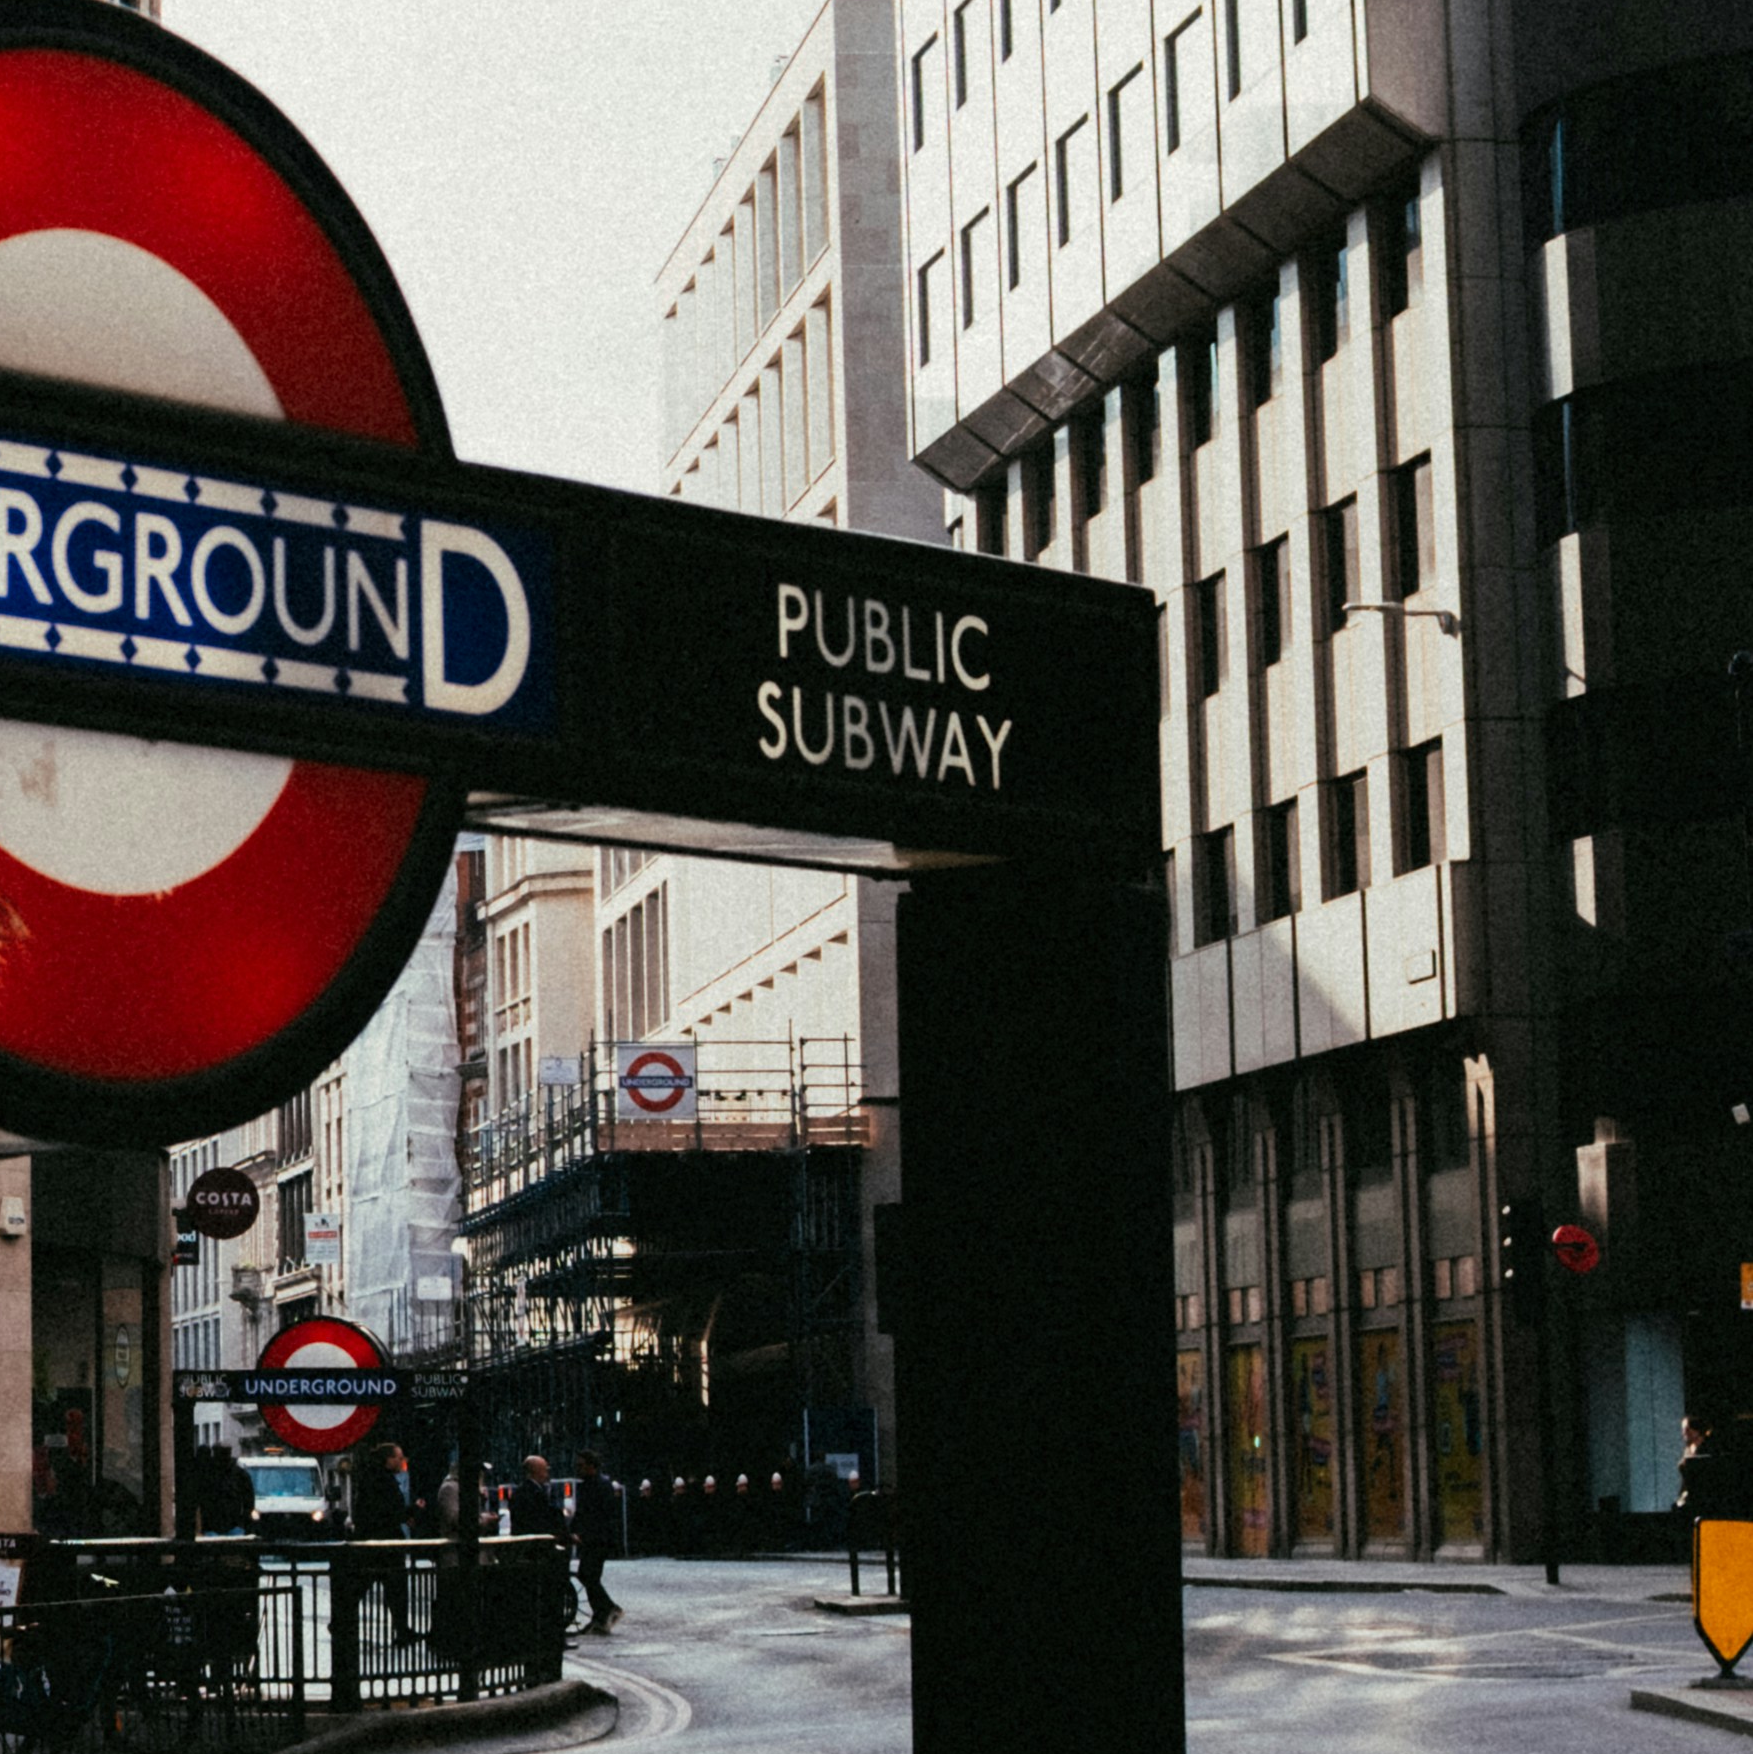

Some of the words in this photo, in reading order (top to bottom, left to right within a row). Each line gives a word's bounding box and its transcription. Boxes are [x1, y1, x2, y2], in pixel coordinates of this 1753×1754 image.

[777, 583, 991, 692] PUBLIC
[757, 681, 1013, 791] SUBWAY
[621, 1078, 691, 1087] UNDERGROUND
[195, 1191, 252, 1208] COSTA
[245, 1379, 397, 1395] UNDERGROUND
[414, 1373, 462, 1385] PUBLIC
[410, 1386, 465, 1398] SUBWAY
